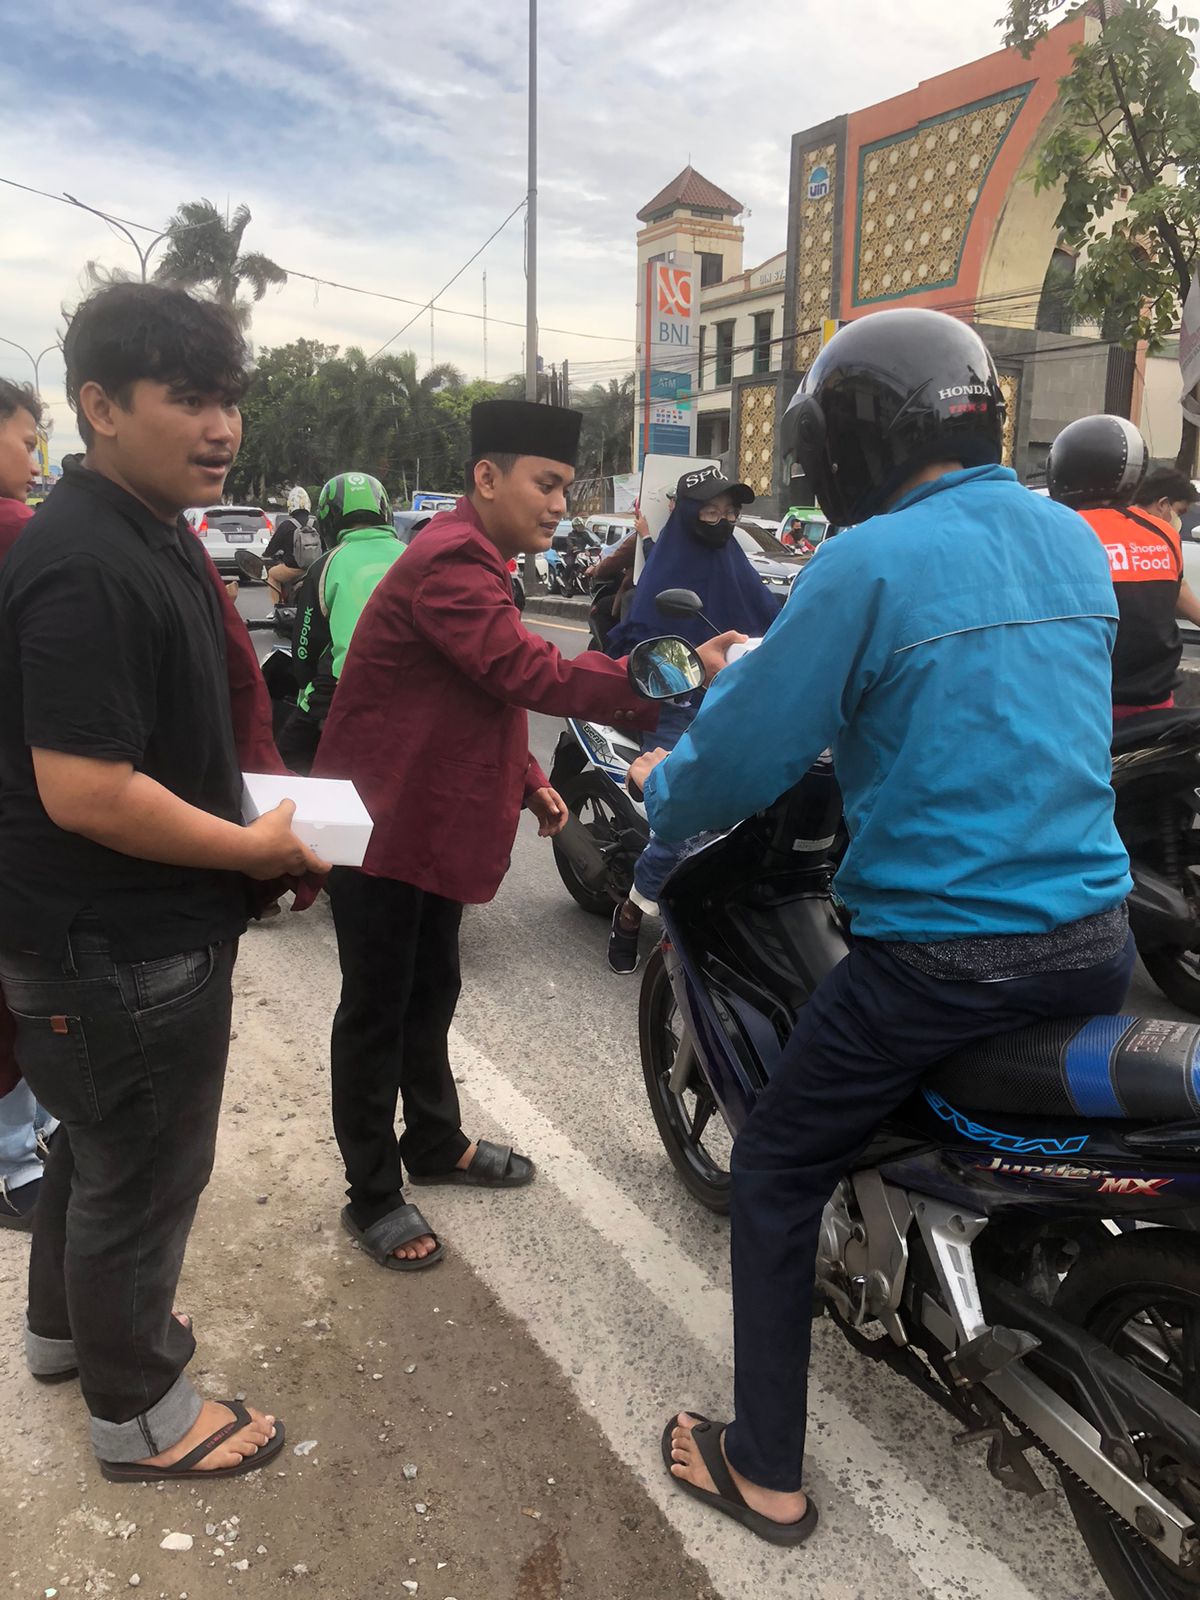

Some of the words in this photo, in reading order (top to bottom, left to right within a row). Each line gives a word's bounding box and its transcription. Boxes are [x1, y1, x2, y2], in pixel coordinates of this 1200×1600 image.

[660, 321, 689, 345] BNI
[938, 384, 992, 400] HONDA
[1129, 542, 1169, 555] Shopee
[1131, 554, 1171, 571] Food
[299, 606, 314, 646] gojek
[975, 1157, 1112, 1180] Jupiter
[1097, 1178, 1175, 1196] MX
